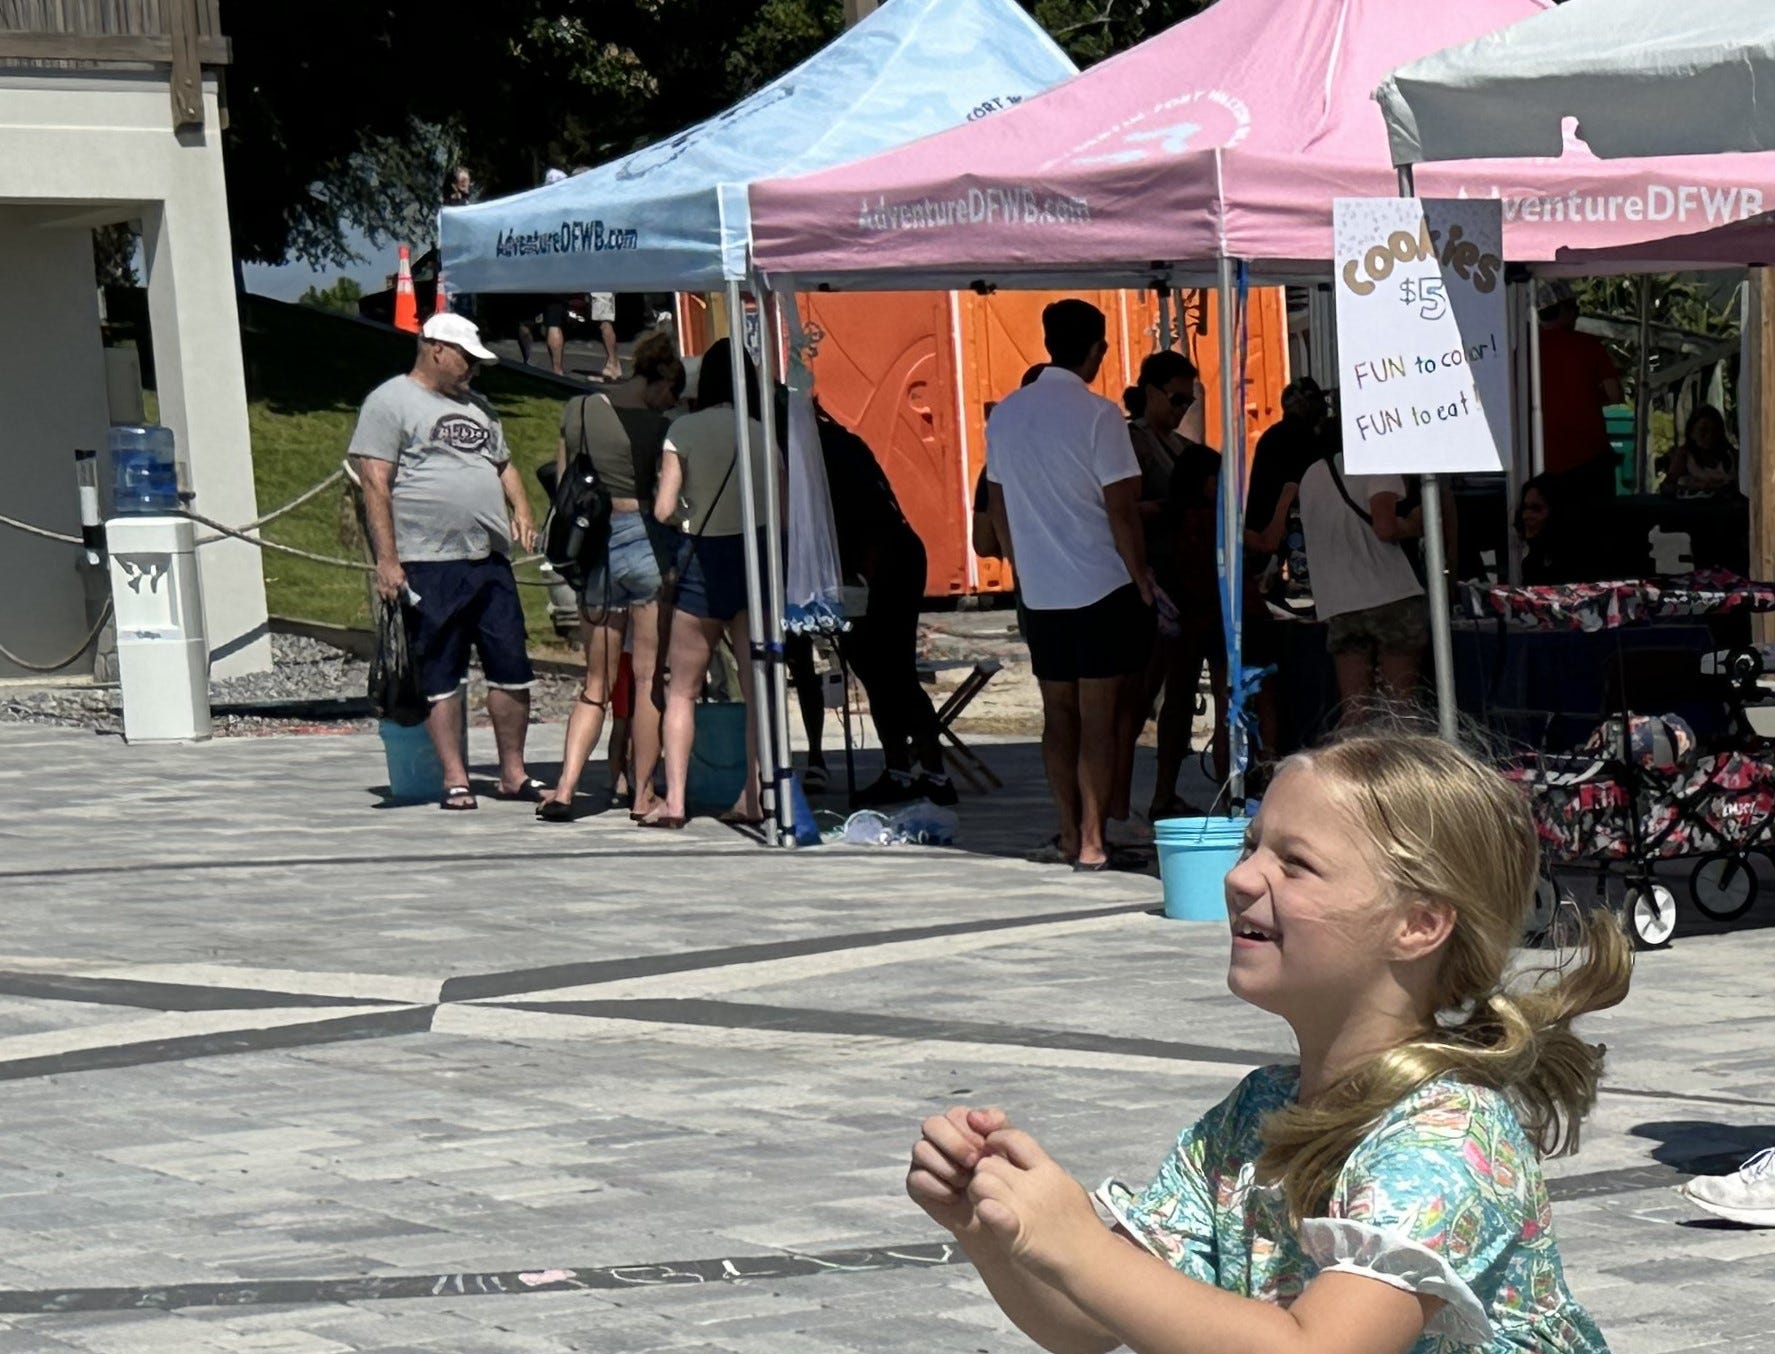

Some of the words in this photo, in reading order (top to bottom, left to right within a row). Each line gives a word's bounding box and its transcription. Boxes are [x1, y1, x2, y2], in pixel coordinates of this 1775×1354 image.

[859, 187, 1091, 231] AdventureDFWB.com
[1400, 277, 1447, 321] $5
[1354, 355, 1406, 390] FUN
[1415, 356, 1436, 374] to
[1441, 333, 1497, 368] coor!
[1356, 407, 1402, 441] FUN
[1411, 406, 1431, 427] to
